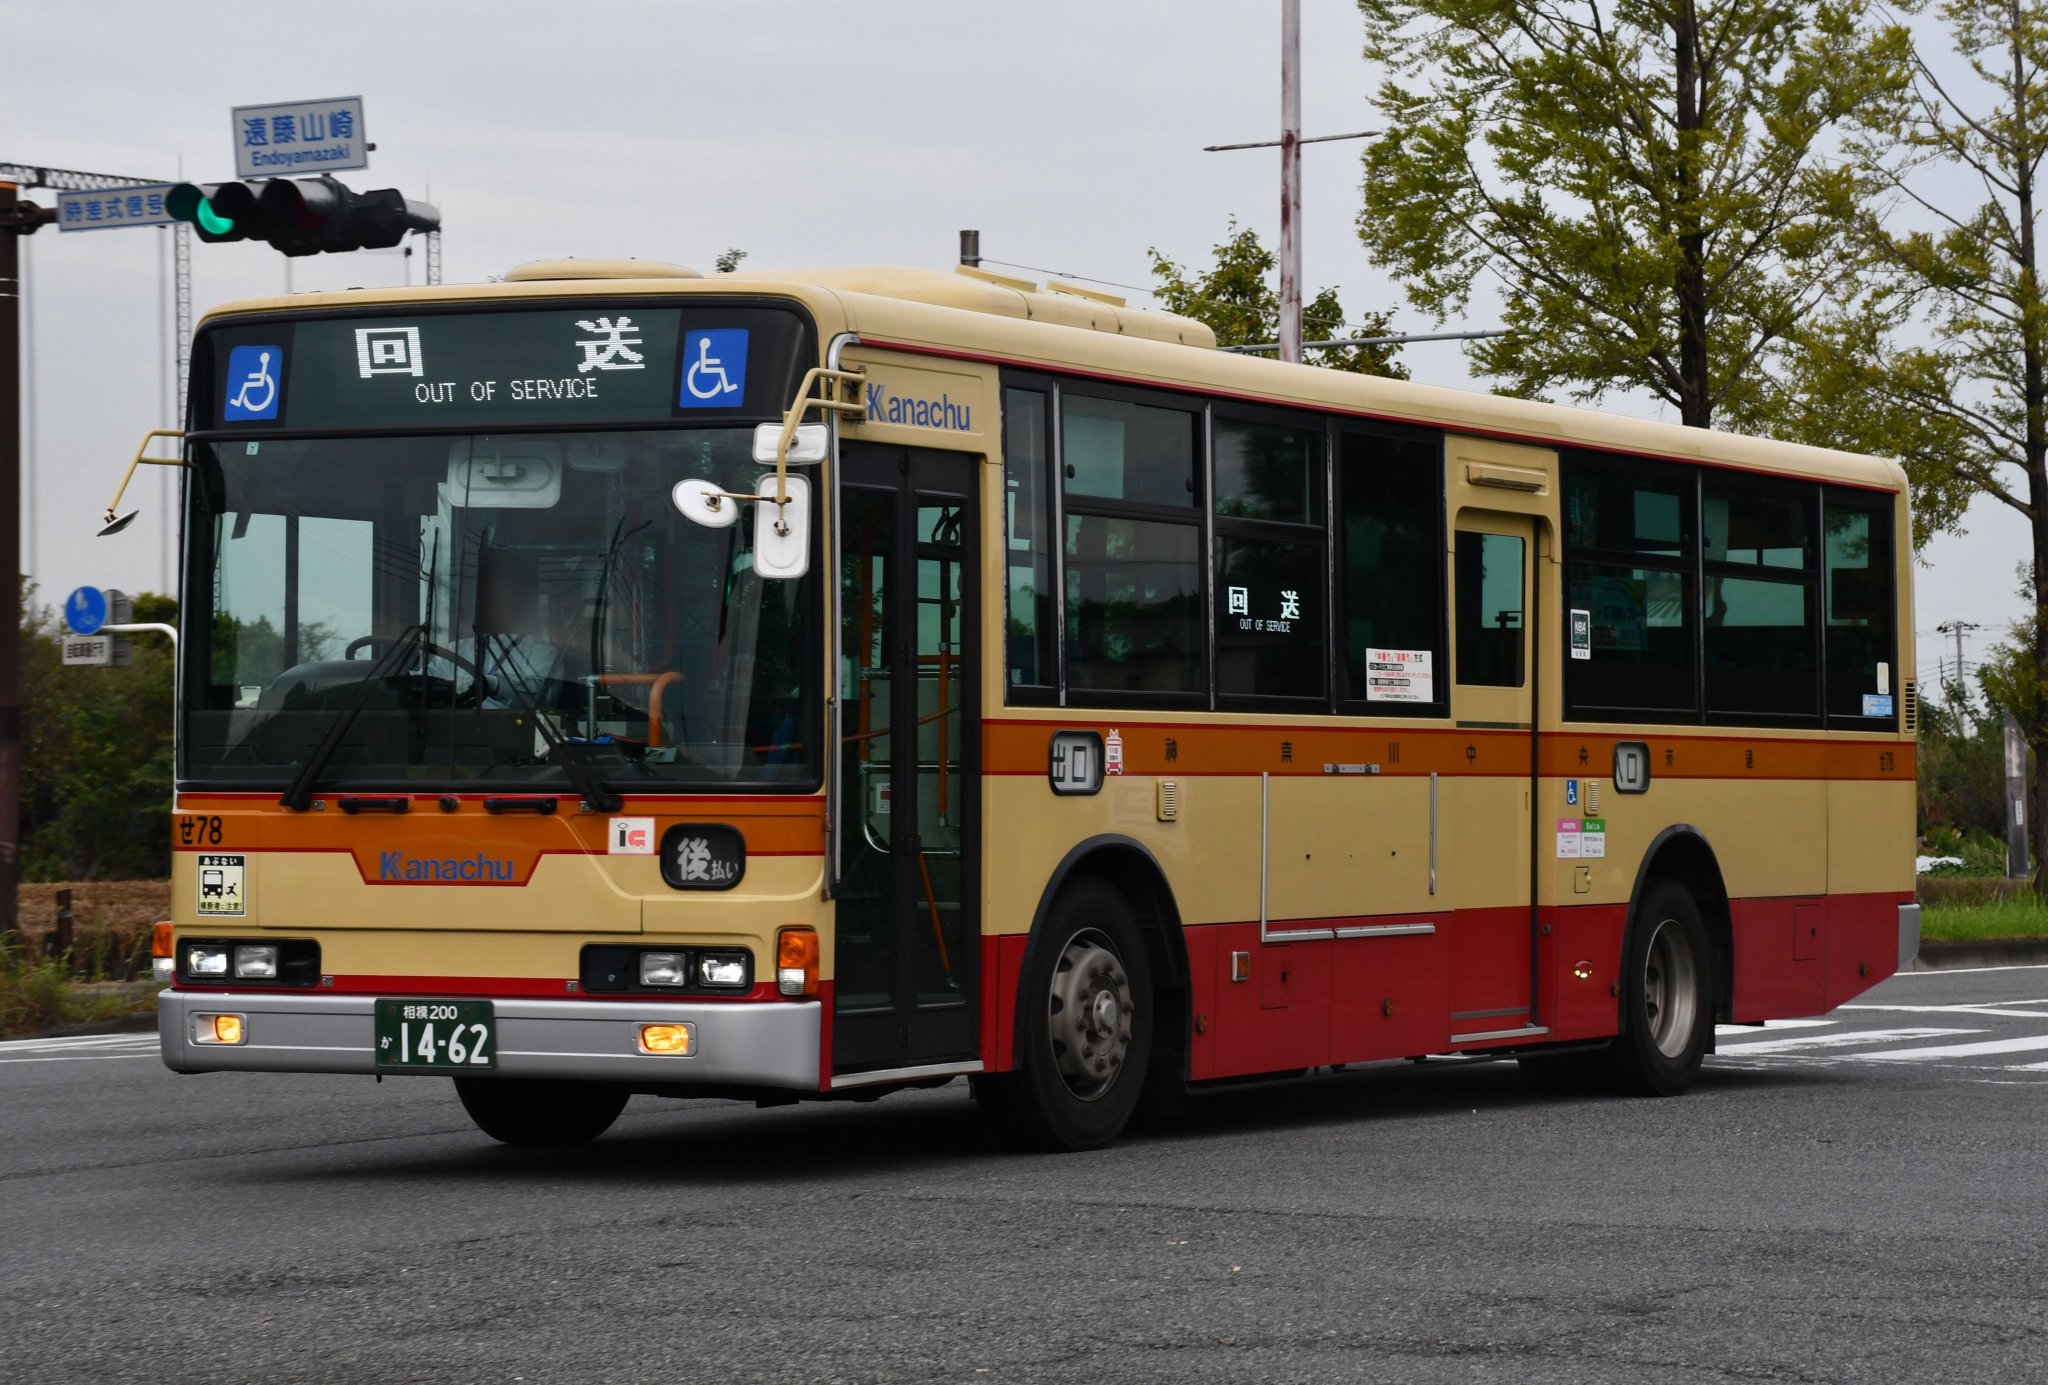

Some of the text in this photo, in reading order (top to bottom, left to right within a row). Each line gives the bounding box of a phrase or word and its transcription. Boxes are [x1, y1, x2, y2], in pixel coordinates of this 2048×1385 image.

[243, 109, 353, 147] 遠藤山崎
[251, 144, 350, 167] Endoyamazaki
[65, 194, 162, 222] 時差式信号
[415, 377, 598, 403] OUT OF SERVICE
[867, 382, 971, 432] Kanachu
[1239, 618, 1291, 633] OUT OF SERVICE
[180, 815, 223, 845] せ78
[203, 856, 238, 866] あぶない
[380, 850, 514, 881] Kanachu
[677, 837, 739, 880] 後払い
[381, 1022, 489, 1064] か 14-62
